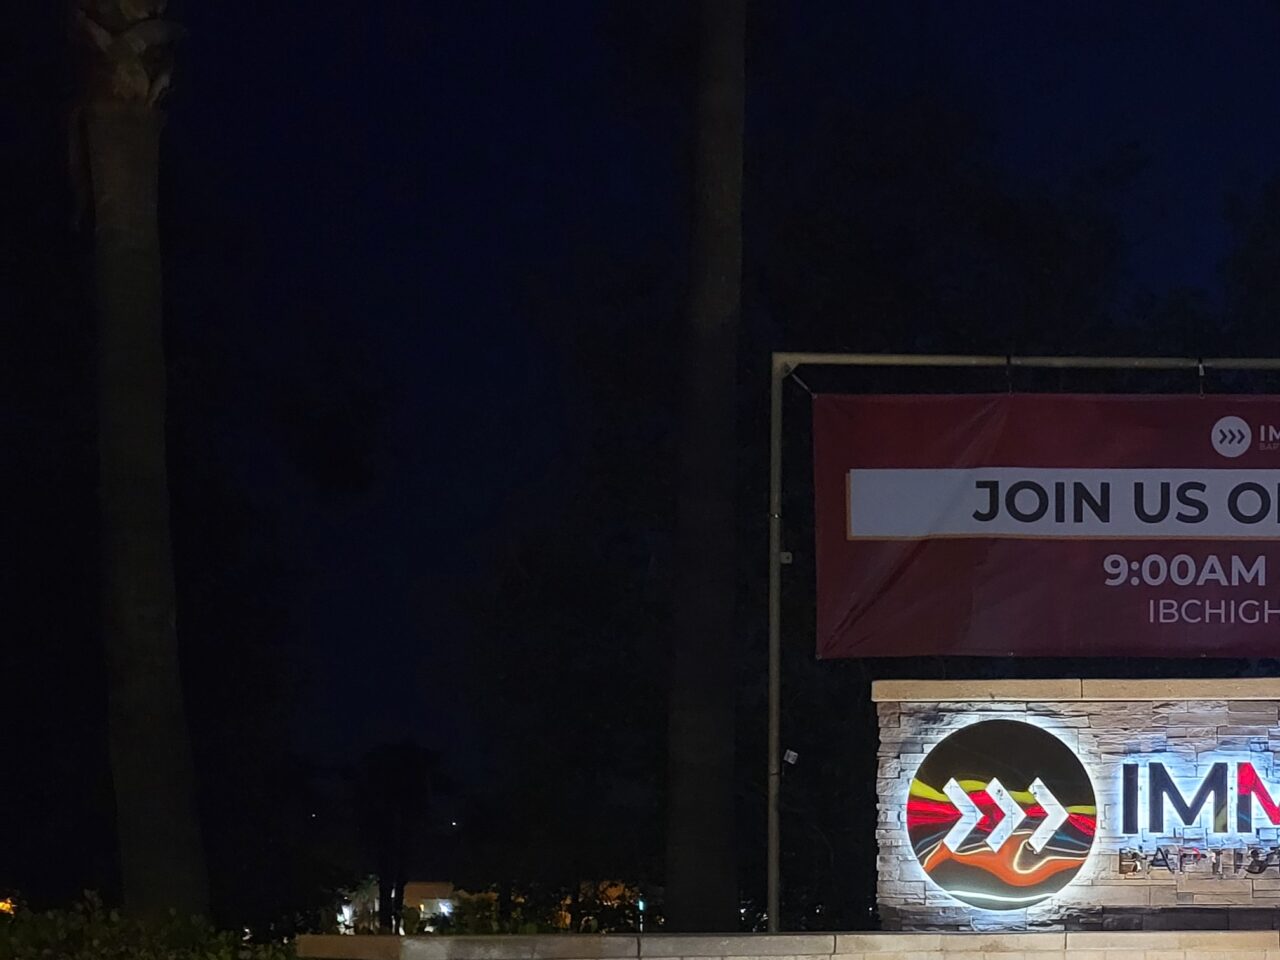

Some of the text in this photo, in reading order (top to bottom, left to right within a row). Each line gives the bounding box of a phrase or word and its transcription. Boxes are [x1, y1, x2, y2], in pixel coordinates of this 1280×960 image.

[972, 480, 1110, 523] JOIN
[1133, 481, 1209, 524] US
[1103, 554, 1266, 586] 9:00AM
